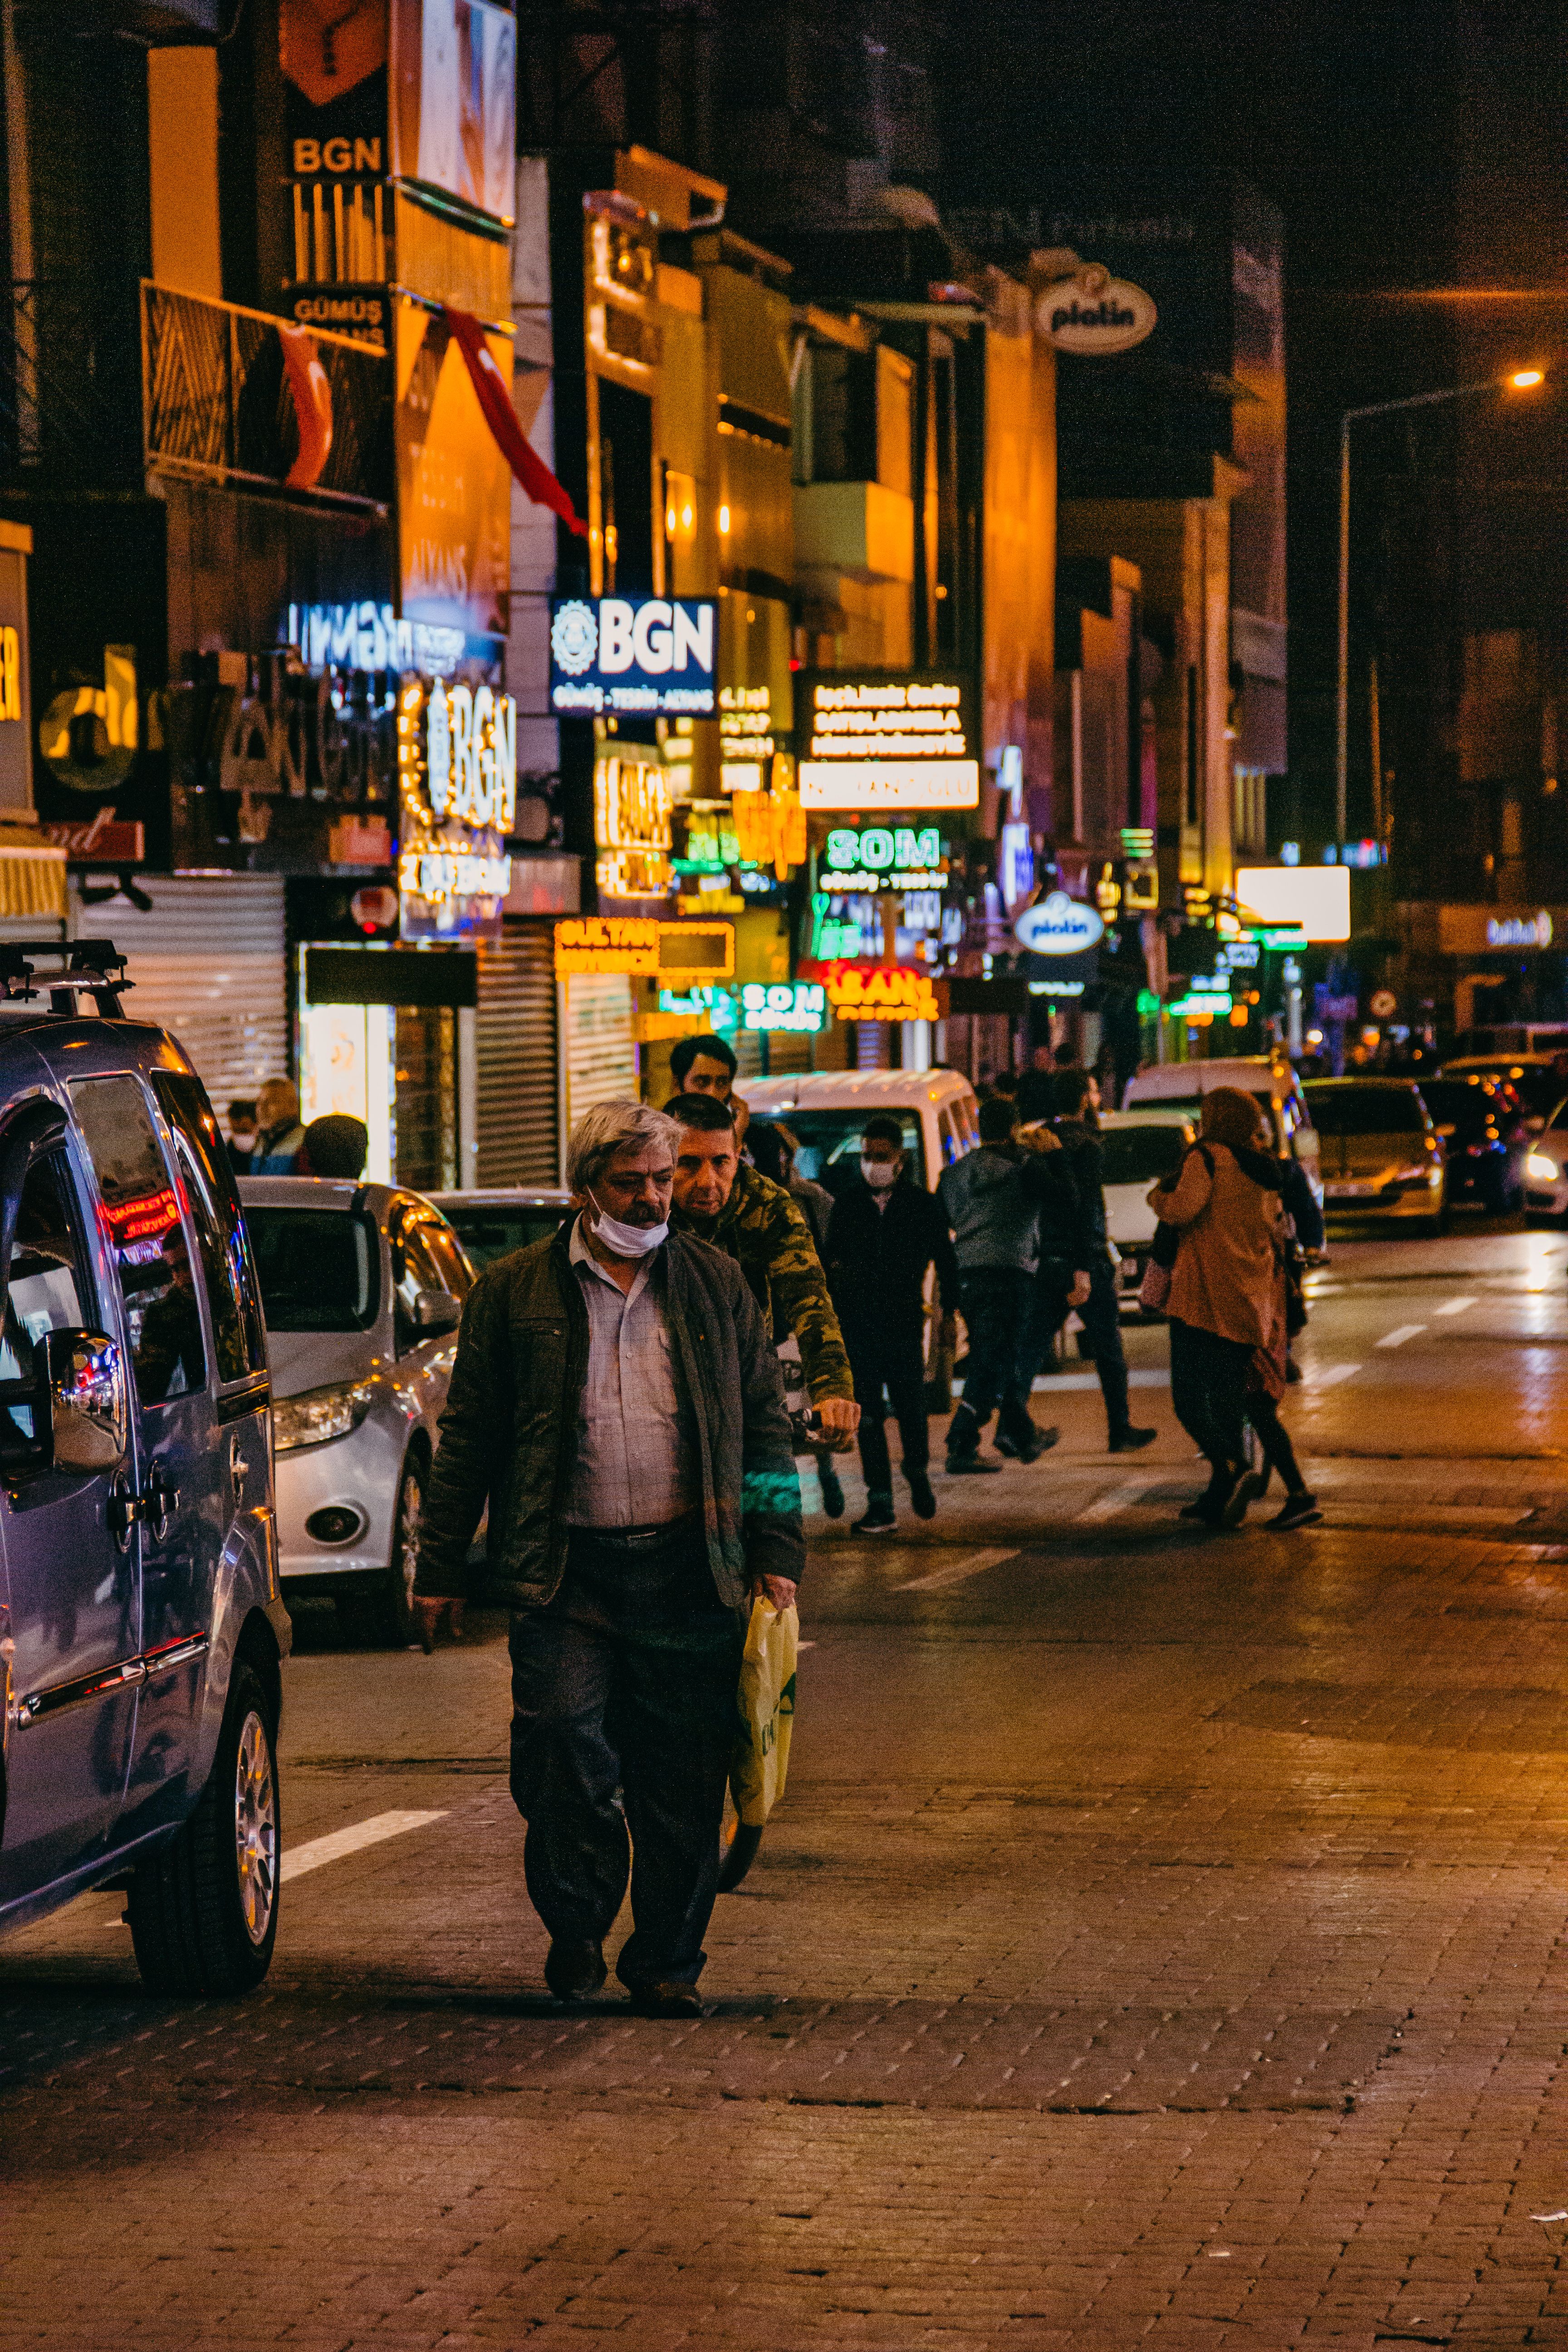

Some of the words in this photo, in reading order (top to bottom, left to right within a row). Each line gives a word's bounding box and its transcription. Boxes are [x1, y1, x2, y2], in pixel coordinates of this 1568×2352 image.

[293, 137, 381, 172] BGN
[294, 295, 383, 326] GÜMÜŞ
[598, 598, 713, 675] BGN
[453, 684, 516, 824] BGN
[827, 828, 940, 869] SOM
[743, 983, 824, 1012] SOM
